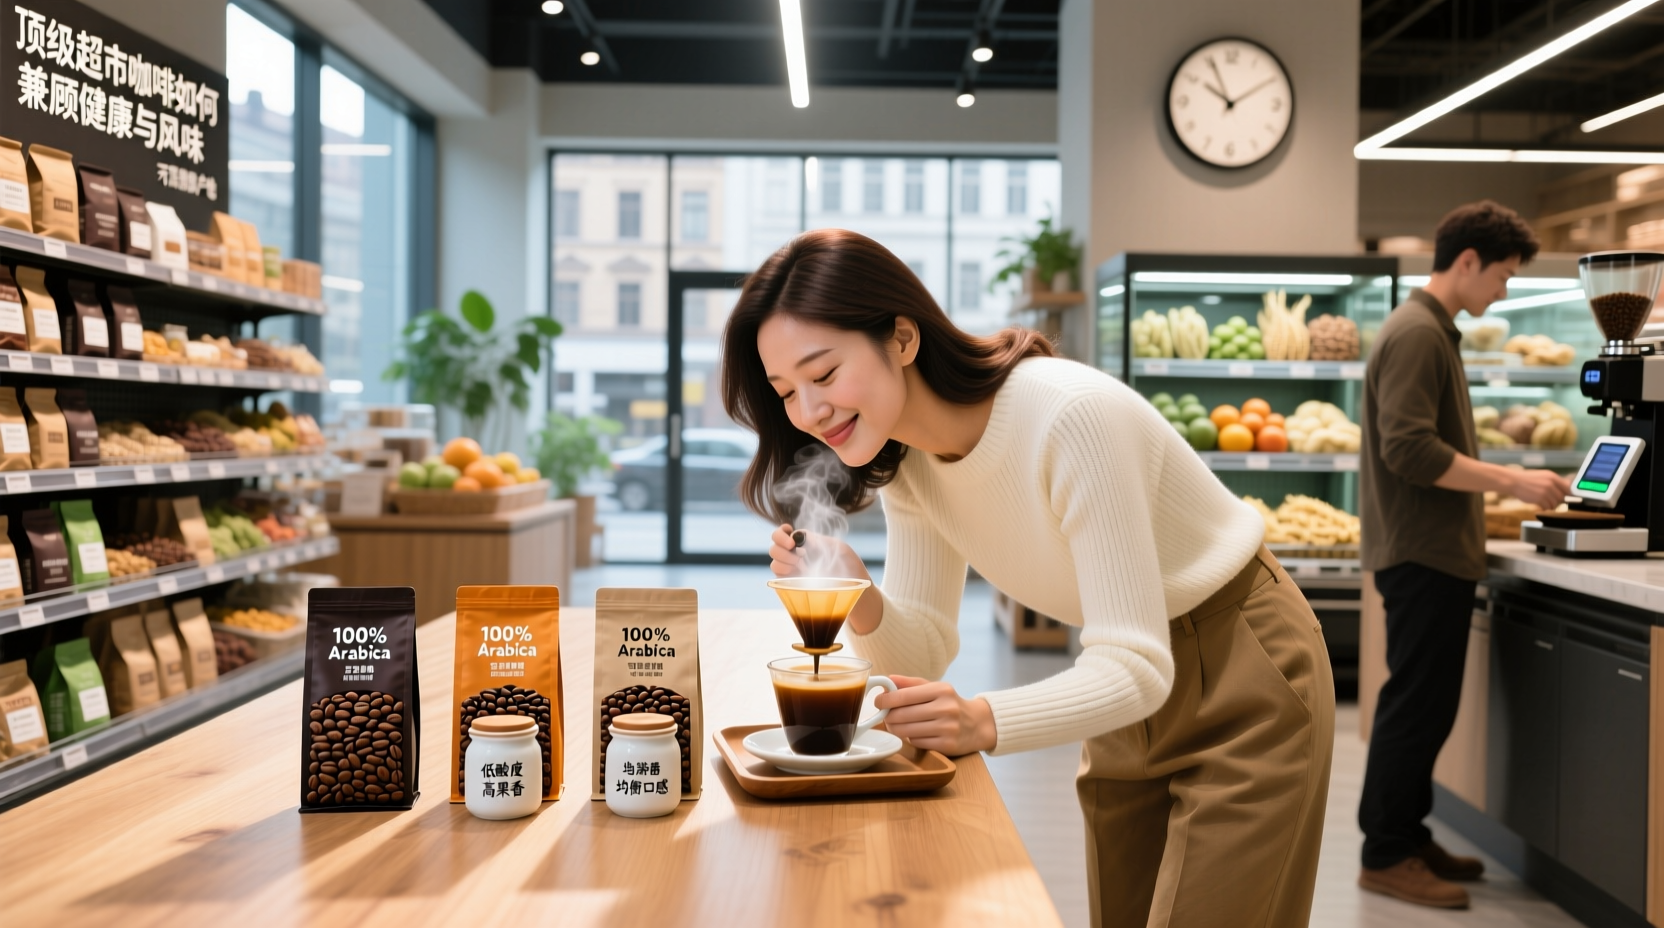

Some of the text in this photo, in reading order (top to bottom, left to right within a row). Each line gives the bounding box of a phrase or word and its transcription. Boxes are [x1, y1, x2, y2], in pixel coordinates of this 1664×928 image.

[15, 5, 219, 127] 顶级超市咖啡如何
[18, 61, 205, 164] 兼顾健康与风味
[332, 626, 388, 644] 100%
[480, 625, 533, 642] 100%
[621, 627, 671, 642] 100%
[328, 645, 391, 660] Arabica
[477, 642, 537, 657] Arabica
[617, 643, 676, 658] Arabica
[482, 779, 525, 798] 高果香
[615, 778, 669, 796] 均衡口感
